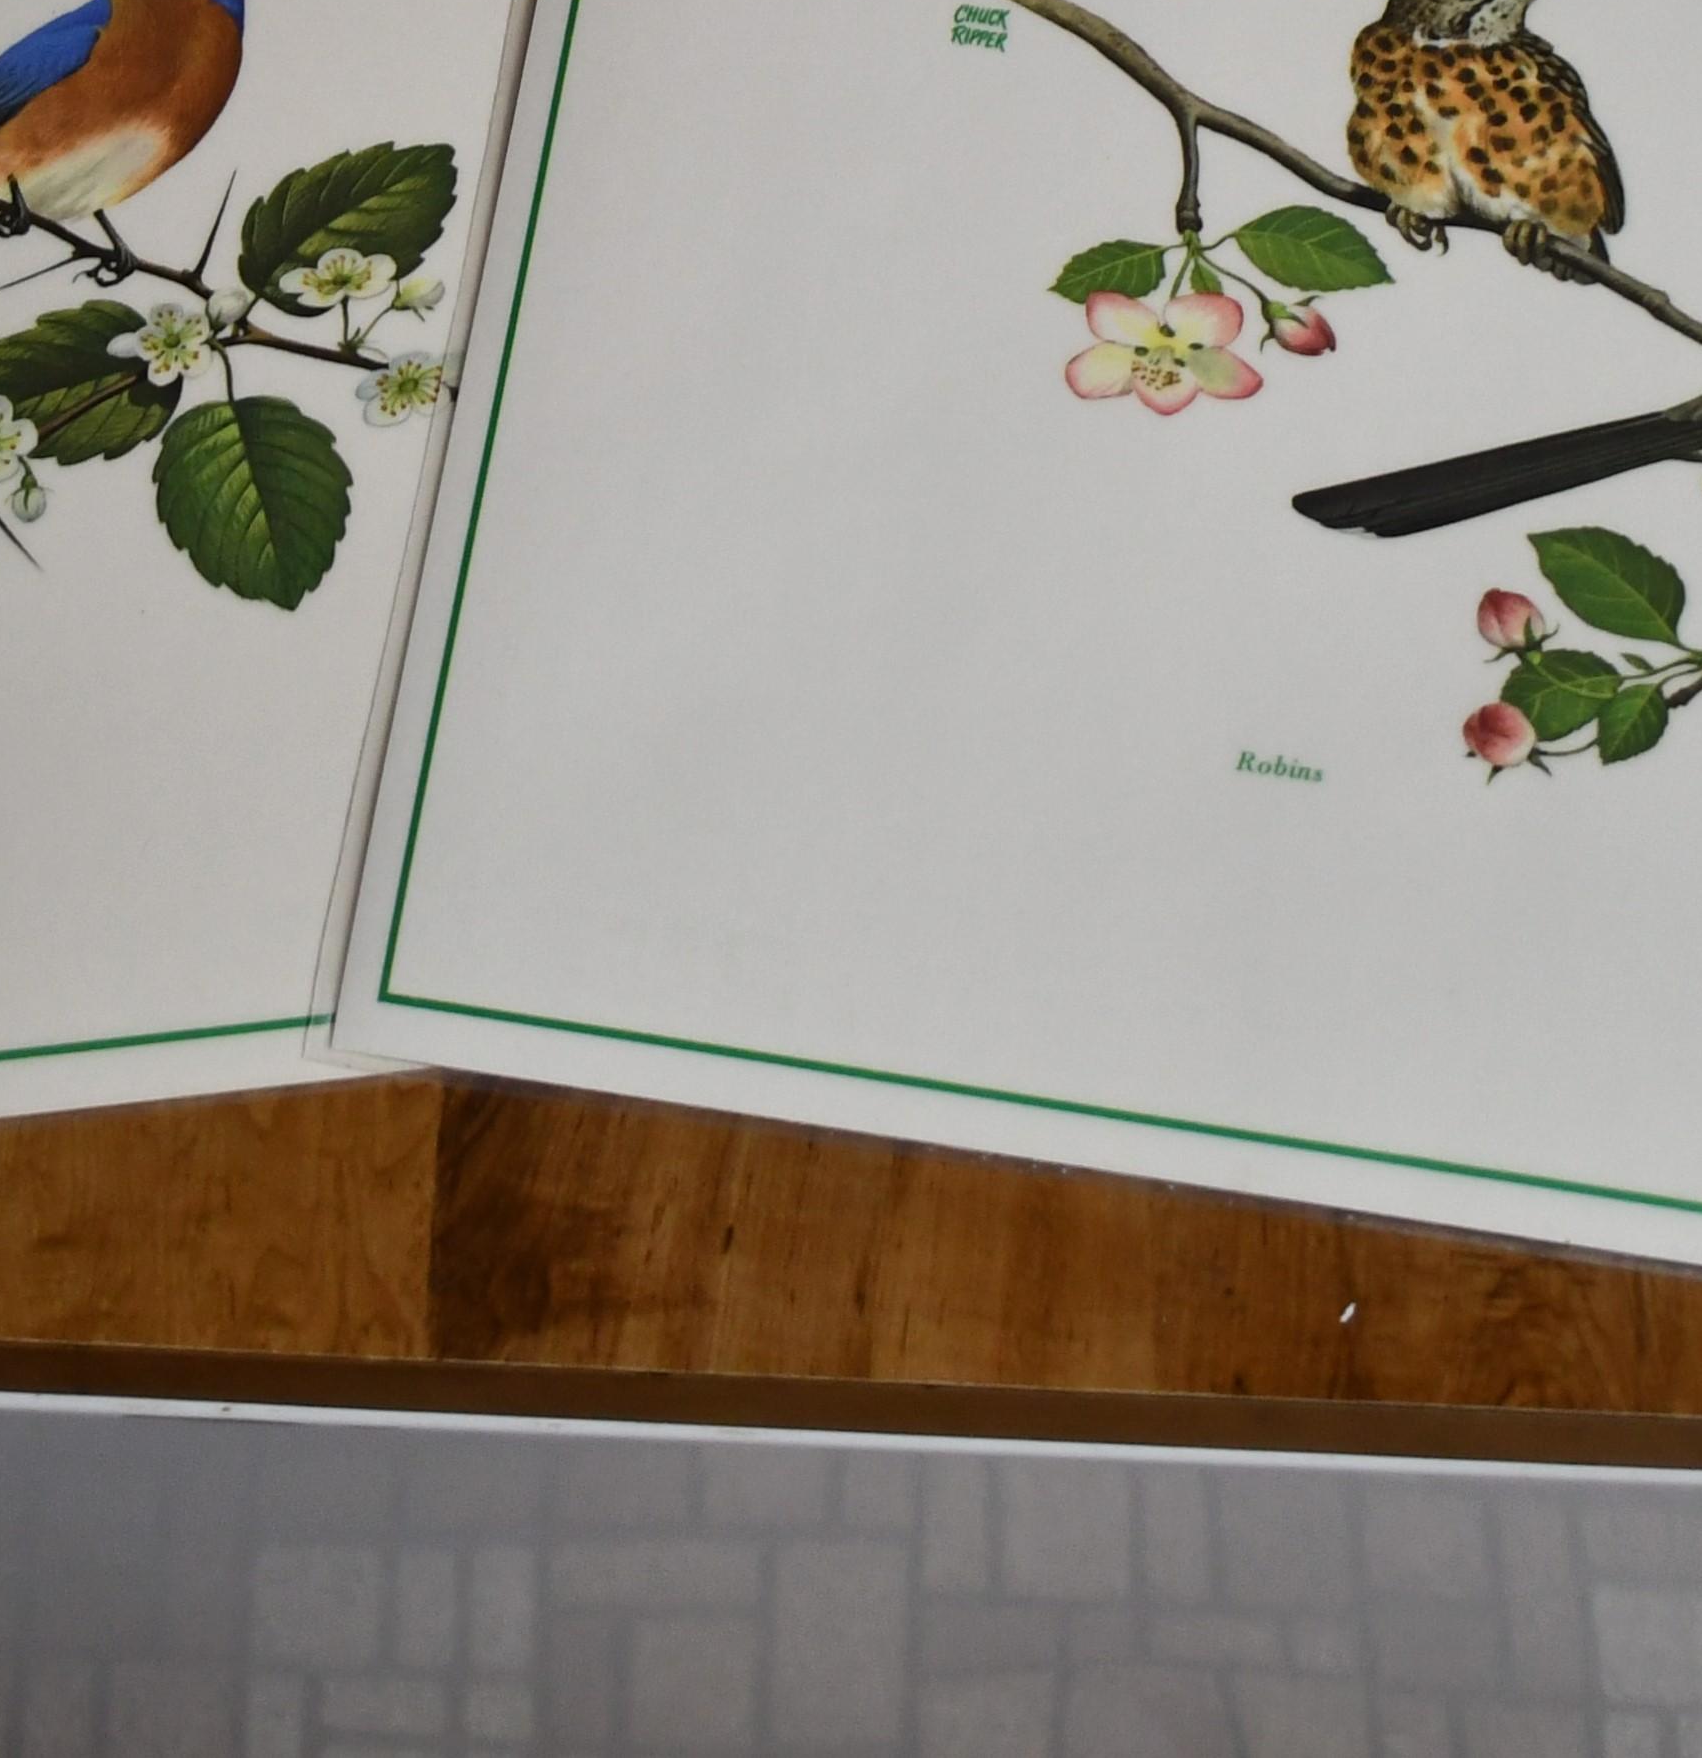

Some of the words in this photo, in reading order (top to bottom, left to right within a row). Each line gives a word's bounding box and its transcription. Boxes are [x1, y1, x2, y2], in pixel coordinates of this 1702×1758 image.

[954, 4, 1010, 30] CHUCK
[951, 25, 1008, 53] RIPPER
[1235, 750, 1324, 782] Robins
